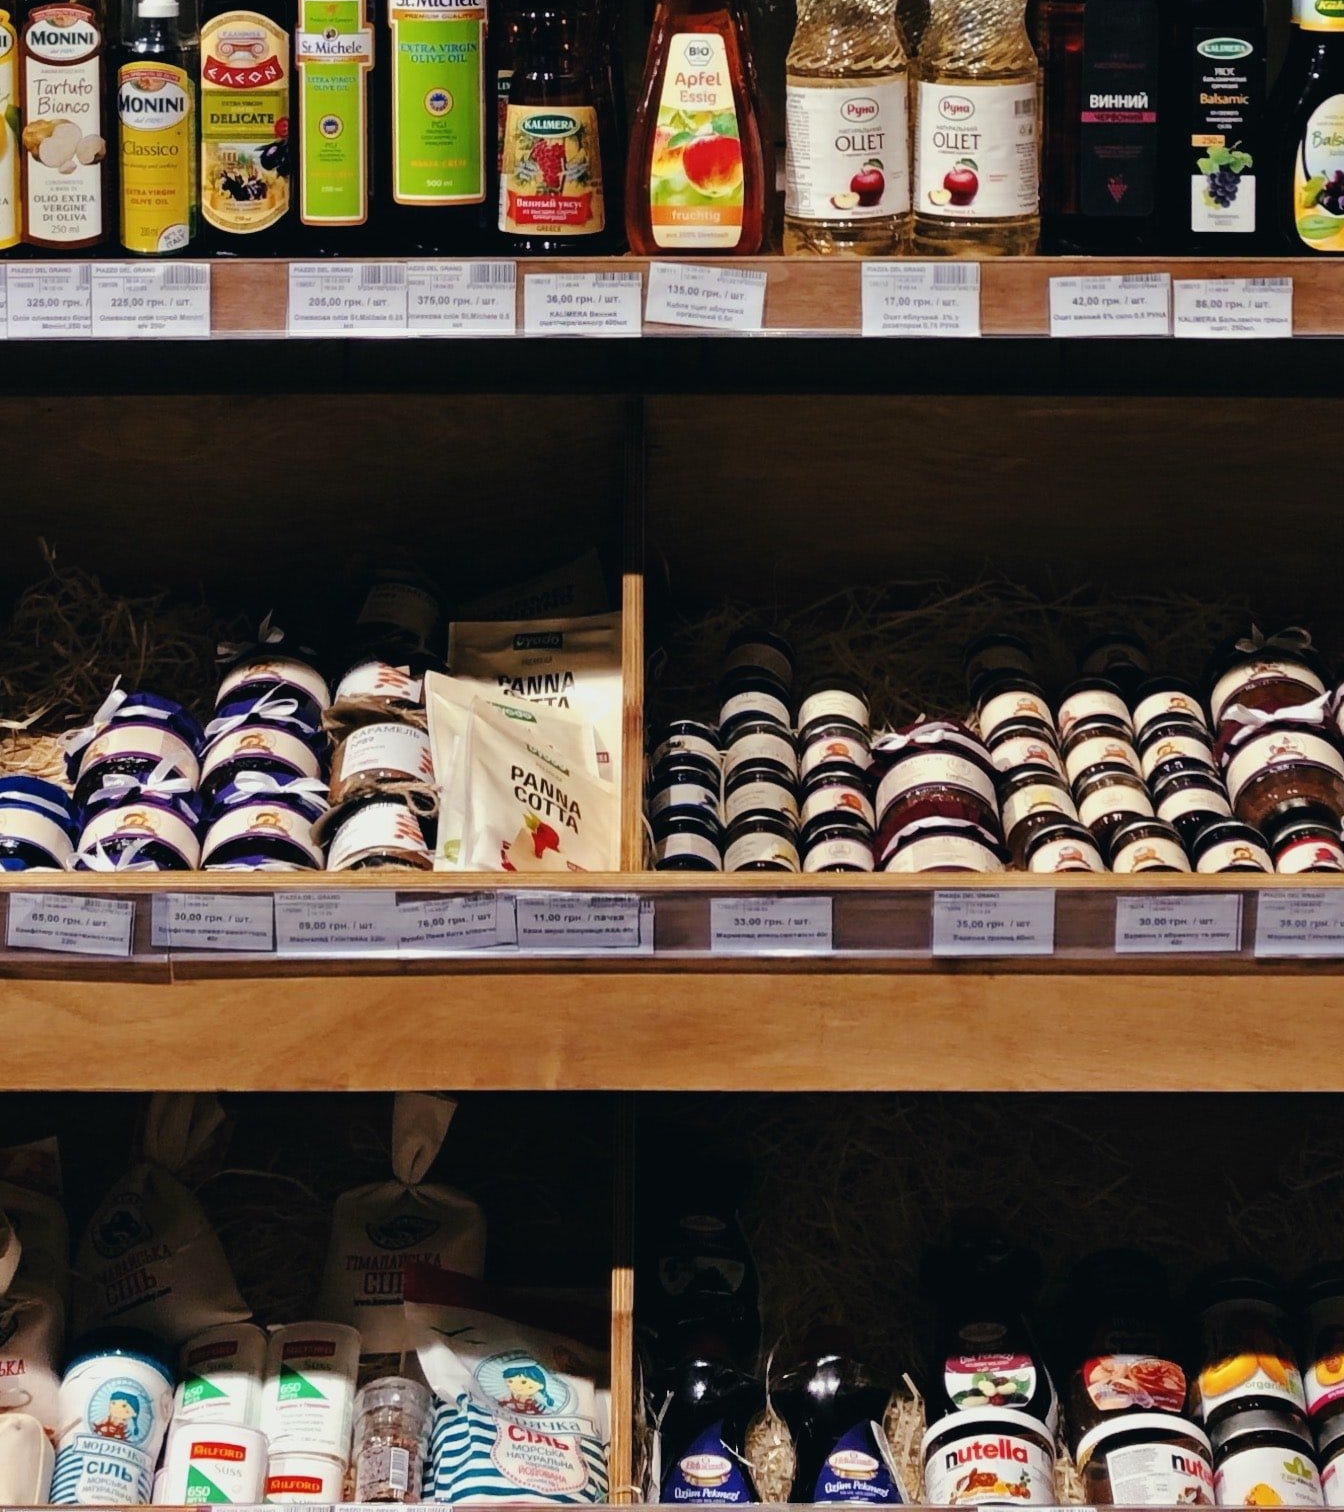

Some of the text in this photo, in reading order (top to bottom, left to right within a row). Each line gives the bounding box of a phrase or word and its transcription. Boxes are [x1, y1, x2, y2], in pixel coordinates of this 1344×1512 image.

[675, 72, 720, 87] Apfel
[33, 80, 92, 96] Tartufo
[680, 90, 716, 106] Essig
[1090, 93, 1149, 110] ВИННИЙ
[1200, 93, 1249, 105] Balsamic
[38, 99, 90, 114] Bianco
[210, 113, 274, 125] DELICATE
[524, 120, 574, 130] KALIMERA
[835, 133, 886, 152] ОЦЕТ
[933, 133, 981, 152] ОЦЕТ
[672, 209, 720, 223] fruchtig
[546, 295, 621, 306] 36,00 грн. шт.
[1072, 296, 1099, 306] 42,00
[1102, 298, 1122, 308] грн.
[511, 765, 581, 819] PANNA
[514, 788, 579, 833] COTTA
[534, 914, 559, 922] 11,00
[564, 914, 581, 923] грн.
[506, 1423, 570, 1452] СІЛЬ
[192, 1445, 245, 1460] MILFORD
[945, 1439, 1028, 1469] nutella
[86, 1461, 133, 1483] СІЛЬ
[269, 1479, 321, 1493] MILFORD
